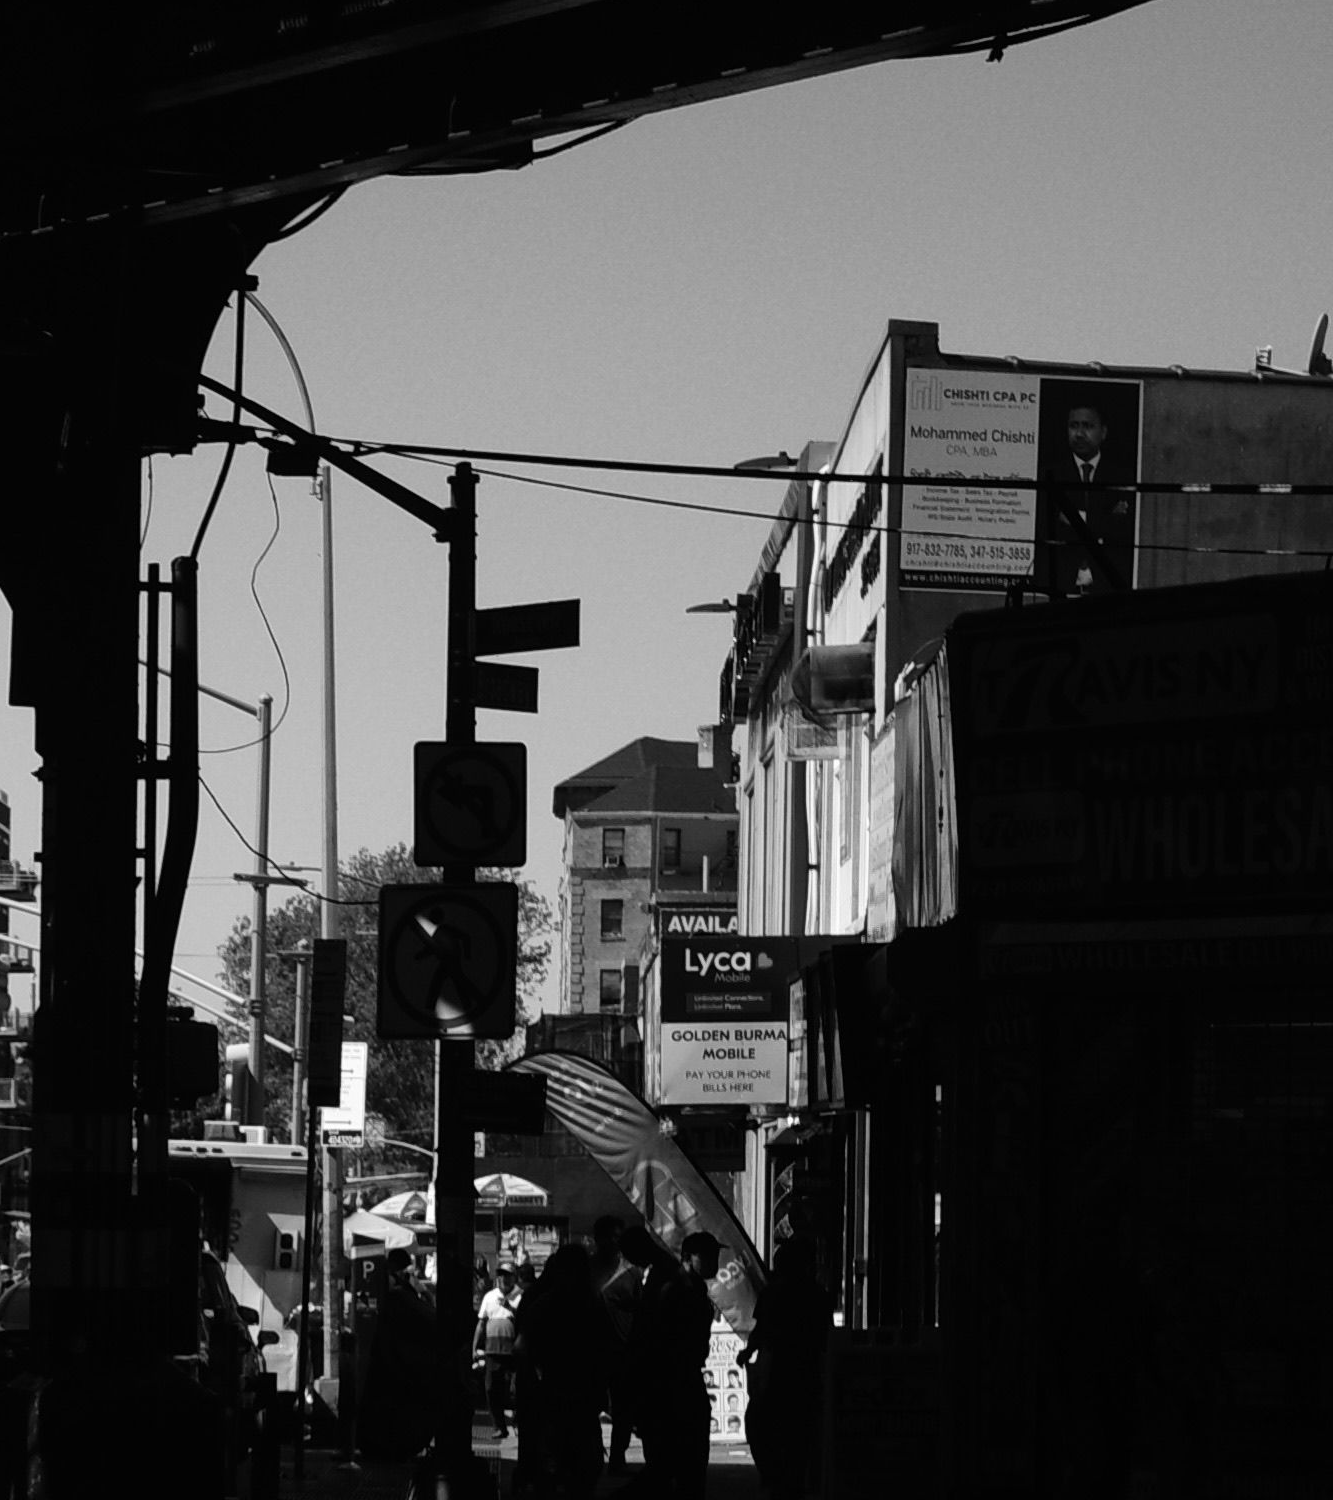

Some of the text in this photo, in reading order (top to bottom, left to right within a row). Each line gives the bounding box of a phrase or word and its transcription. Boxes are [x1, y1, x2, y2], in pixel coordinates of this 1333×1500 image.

[943, 388, 1036, 404] CHISHTI CPA PC
[910, 425, 1035, 444] Mohammed Chishti
[973, 446, 997, 457] MBA
[1198, 644, 1269, 695] NY
[970, 753, 1061, 790] CELL
[1077, 739, 1220, 783] PHONE
[684, 947, 752, 977] Lyca
[1057, 941, 1229, 971] WHOLESALE
[714, 972, 751, 983] Mobile
[671, 1029, 787, 1042] GOLDEN BURMA
[703, 1048, 755, 1060] MOBILE
[686, 1069, 771, 1080] PAY YOUR PHONE
[702, 1083, 754, 1093] BILLS HERE
[363, 1261, 375, 1279] P
